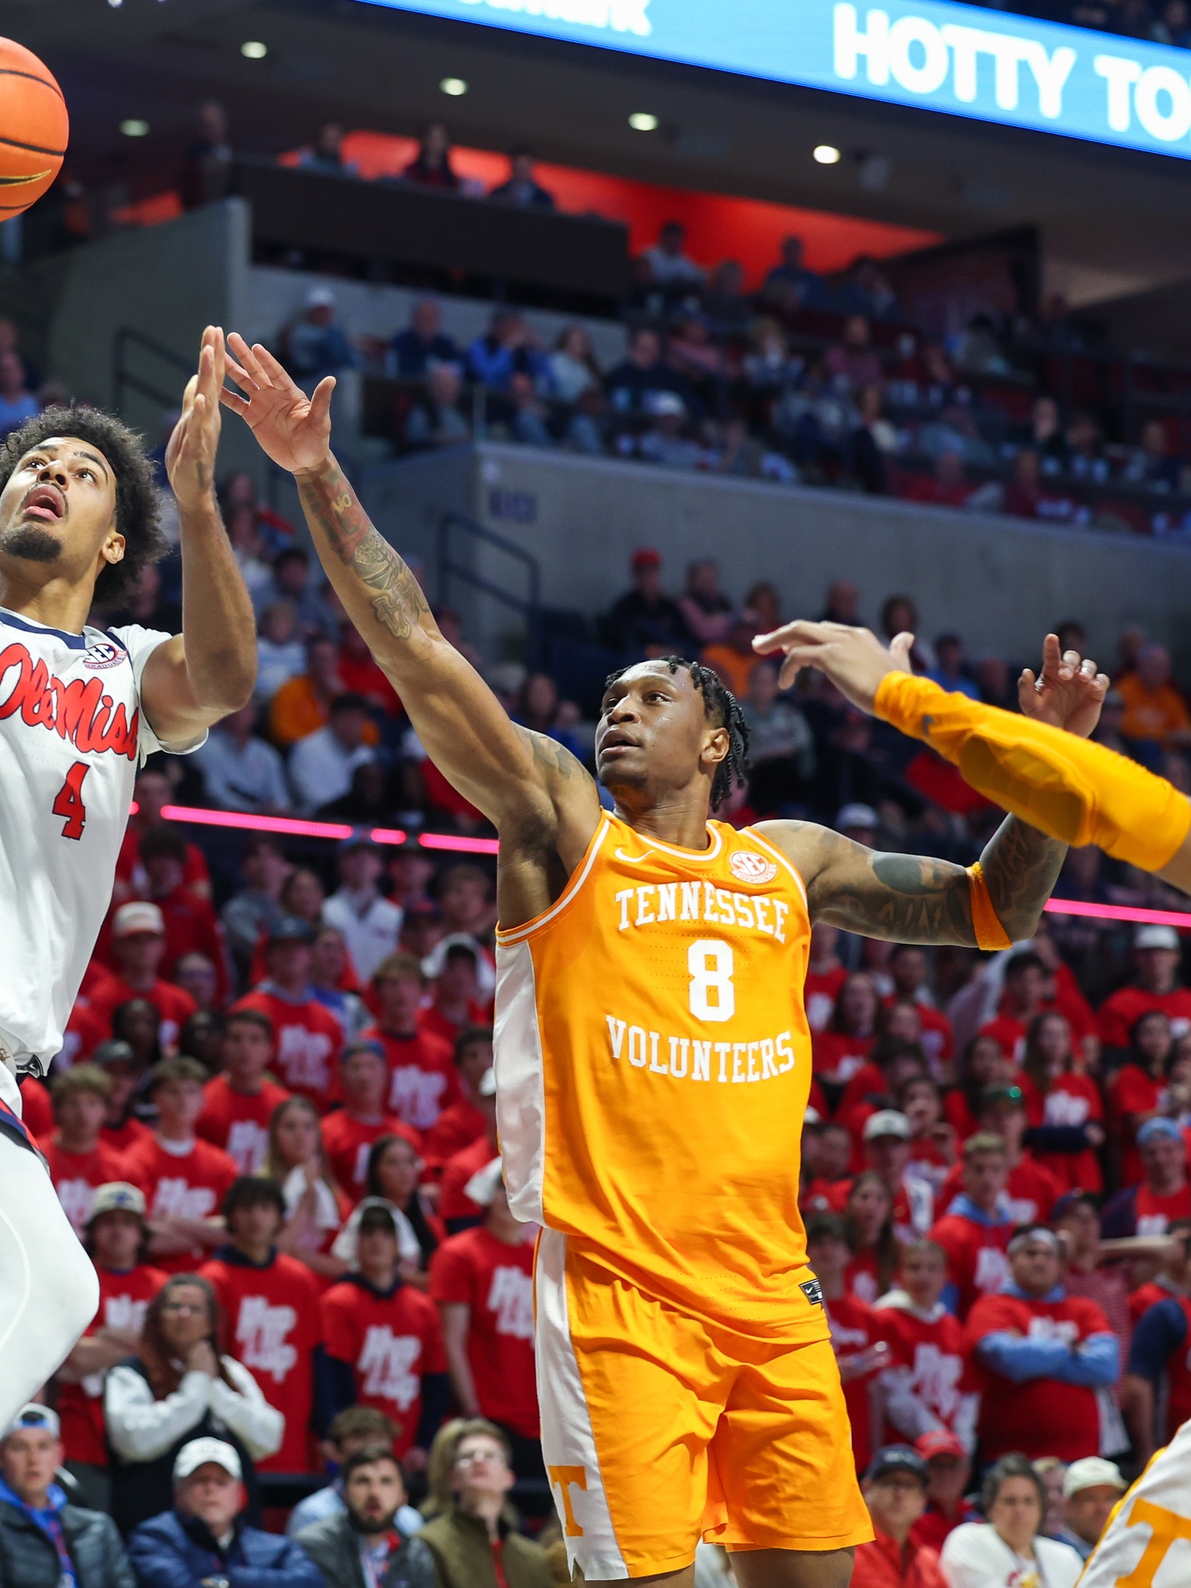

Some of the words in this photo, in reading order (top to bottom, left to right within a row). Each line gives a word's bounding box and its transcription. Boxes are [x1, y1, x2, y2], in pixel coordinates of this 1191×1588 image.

[833, 3, 1077, 119] HOTTY
[1093, 54, 1191, 142] TO
[84, 644, 115, 663] SEC
[52, 760, 91, 841] 4
[731, 852, 767, 876] SEC
[615, 880, 789, 944] TENNESSEE
[687, 939, 736, 1023] 8
[605, 1014, 796, 1084] VOLUNTEERS
[548, 1465, 587, 1537] T
